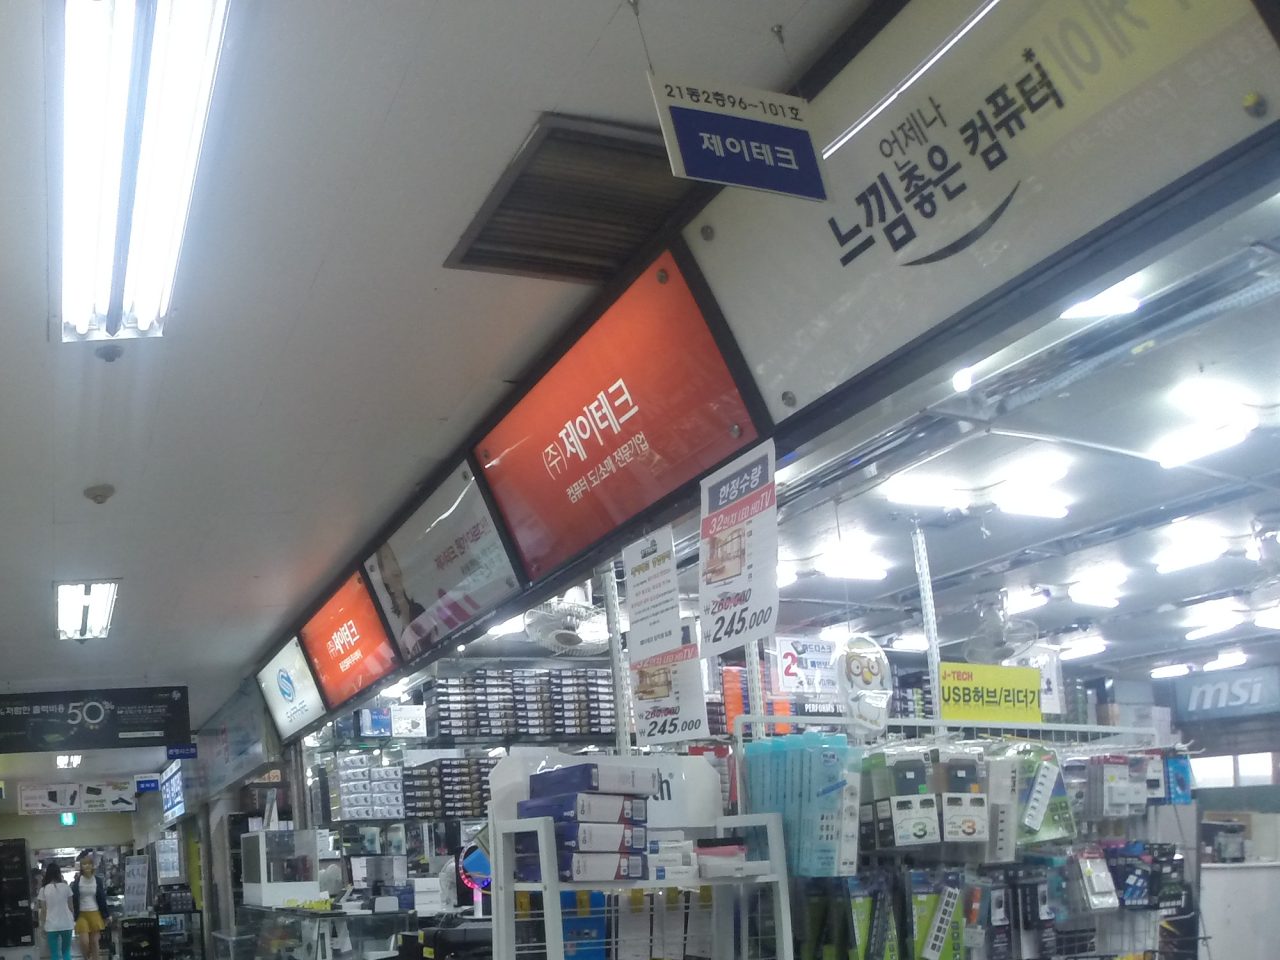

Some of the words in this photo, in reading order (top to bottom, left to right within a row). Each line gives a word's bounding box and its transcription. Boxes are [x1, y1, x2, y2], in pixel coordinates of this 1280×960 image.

[699, 131, 800, 171] 제이테크
[878, 96, 949, 172] 언제나
[828, 147, 968, 268] 느낌좋은
[958, 62, 1065, 171] 컴퓨터
[941, 671, 974, 682] J-TECH
[941, 686, 1041, 709] USB허브/리더기
